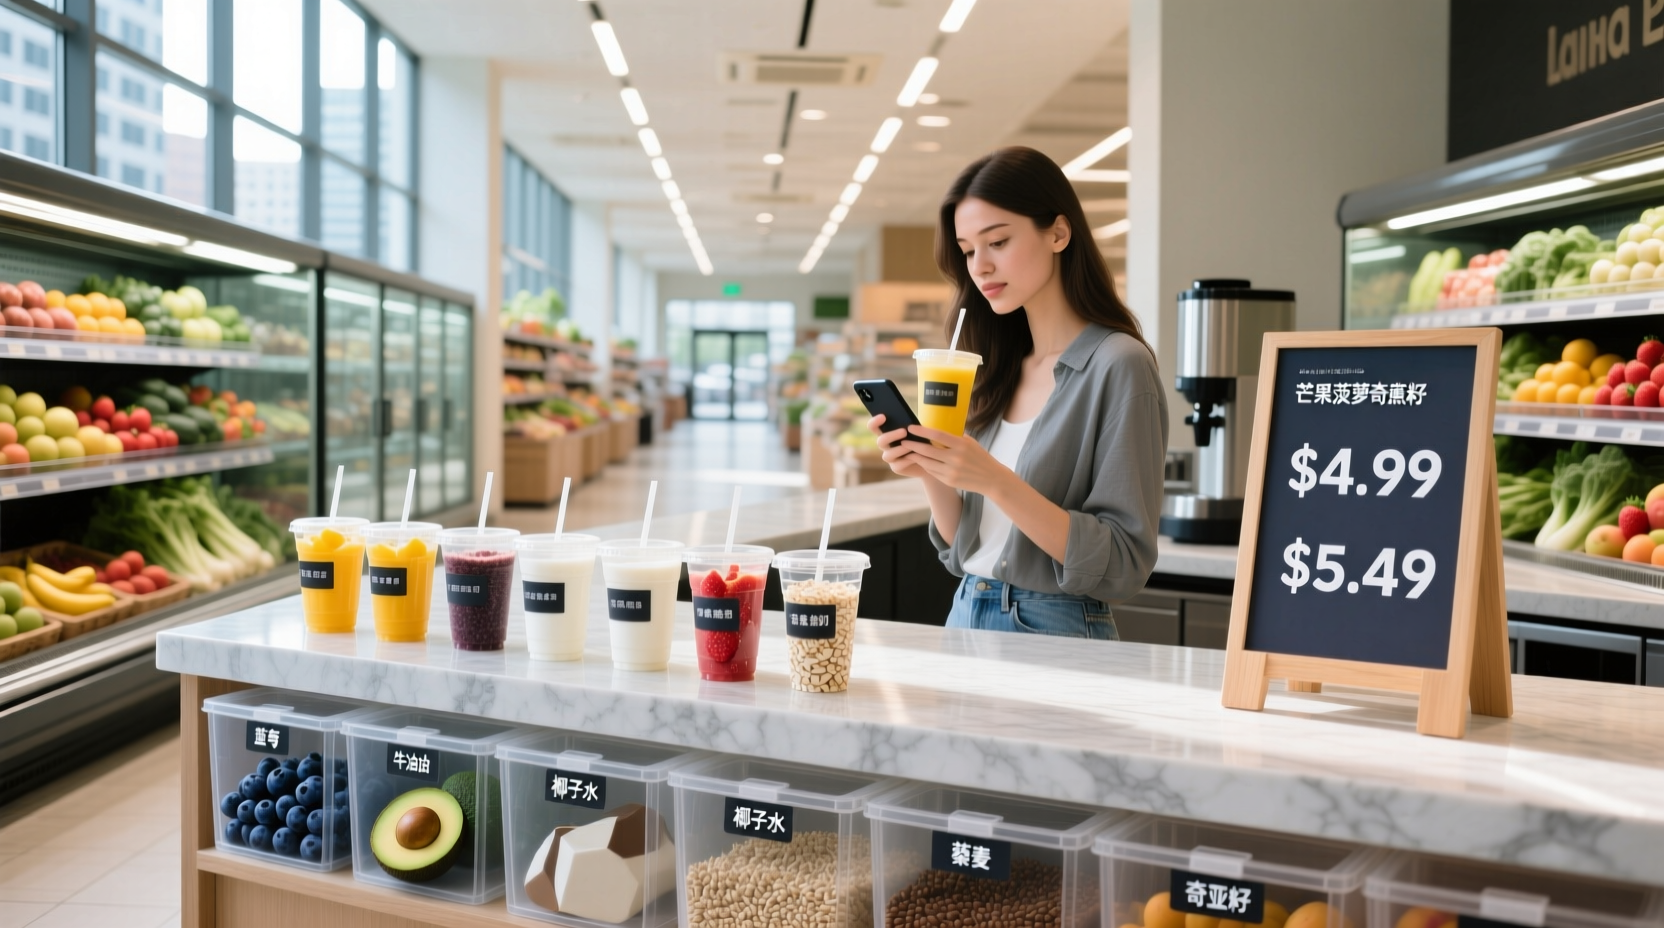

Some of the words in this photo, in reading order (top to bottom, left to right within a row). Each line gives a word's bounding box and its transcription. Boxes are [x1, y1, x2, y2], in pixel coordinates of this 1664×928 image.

[1288, 443, 1442, 498] $4.99
[1281, 537, 1436, 599] $5.49
[1185, 879, 1251, 913] 奇亚籽
